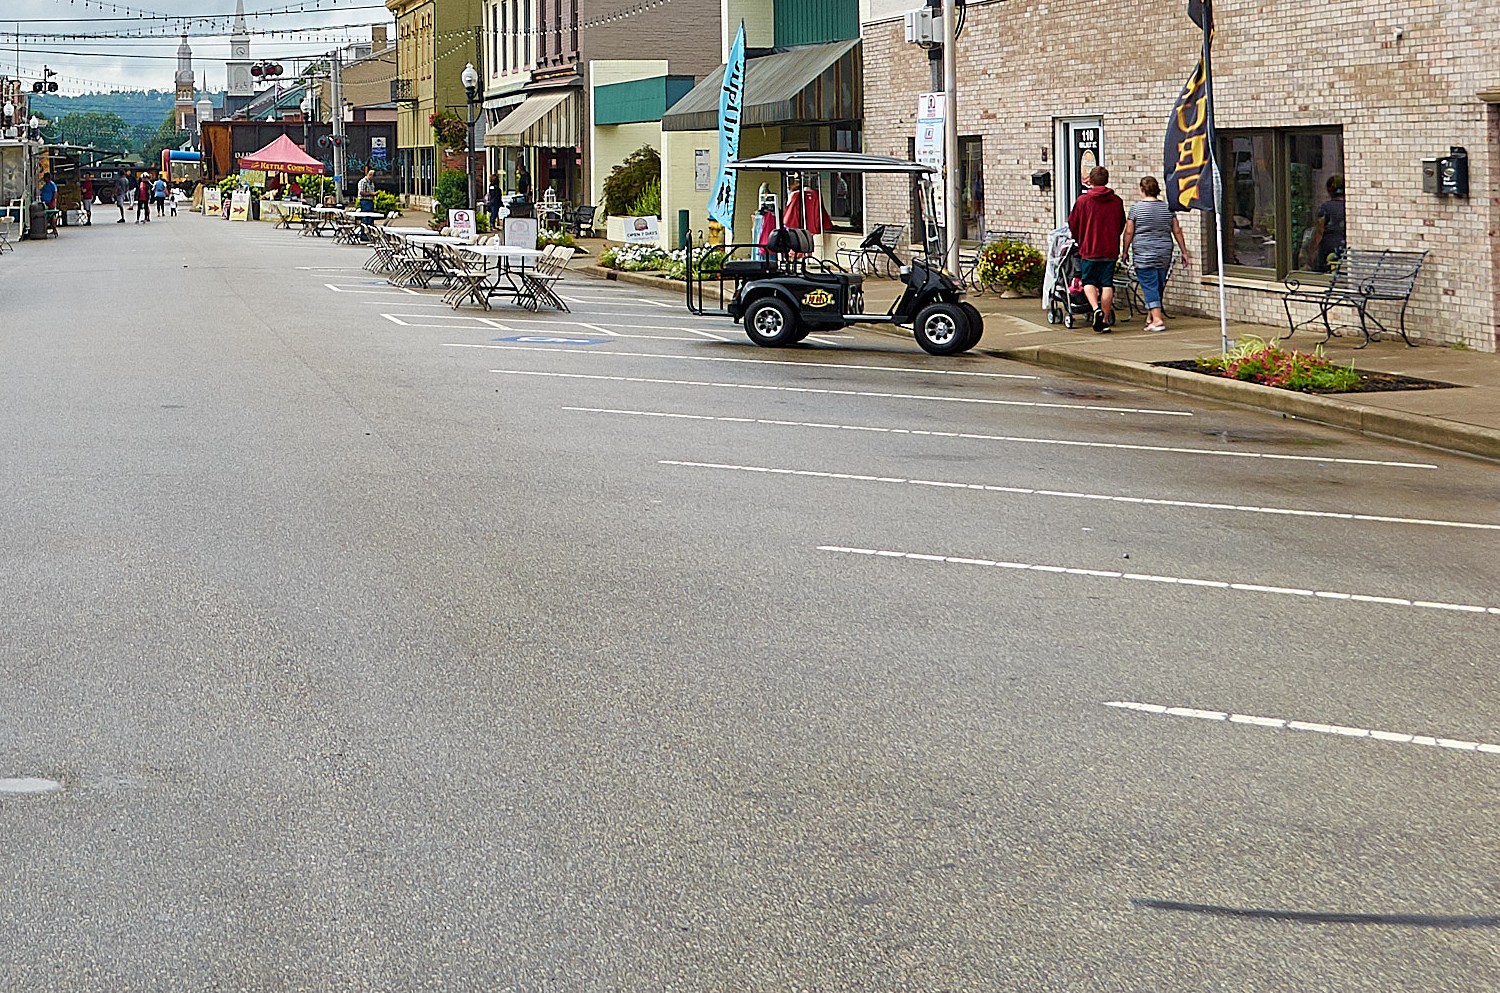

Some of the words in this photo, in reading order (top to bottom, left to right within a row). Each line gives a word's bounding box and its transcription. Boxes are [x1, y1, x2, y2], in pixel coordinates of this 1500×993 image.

[1082, 130, 1094, 141] 110
[260, 162, 284, 170] KETTLE
[287, 164, 305, 172] CORN
